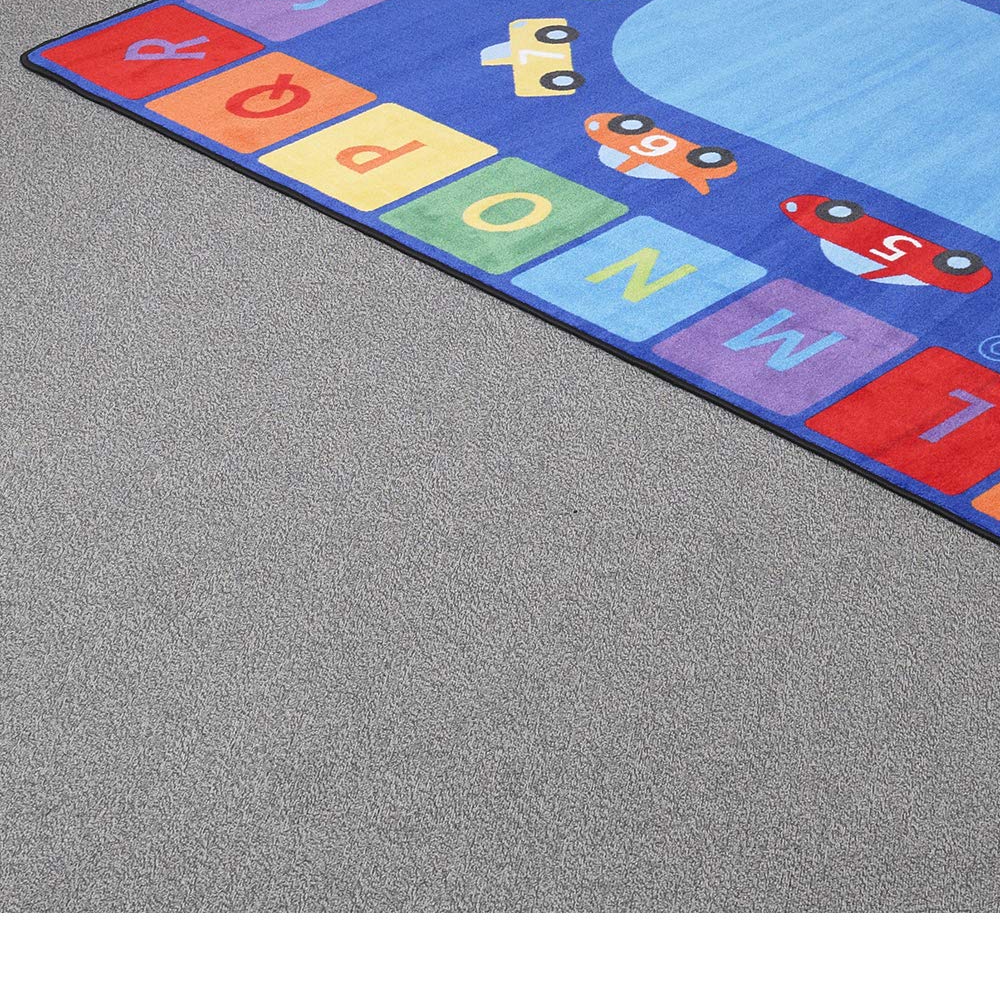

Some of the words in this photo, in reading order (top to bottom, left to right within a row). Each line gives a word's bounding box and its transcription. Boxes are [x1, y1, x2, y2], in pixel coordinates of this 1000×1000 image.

[125, 35, 210, 61] R
[518, 49, 565, 65] 7
[225, 73, 311, 119] Q
[336, 139, 424, 174] P
[628, 135, 677, 158] 6
[462, 191, 552, 232] O
[870, 234, 923, 261] 5
[585, 247, 697, 302] N
[723, 307, 845, 372] M
[918, 388, 996, 444] L
